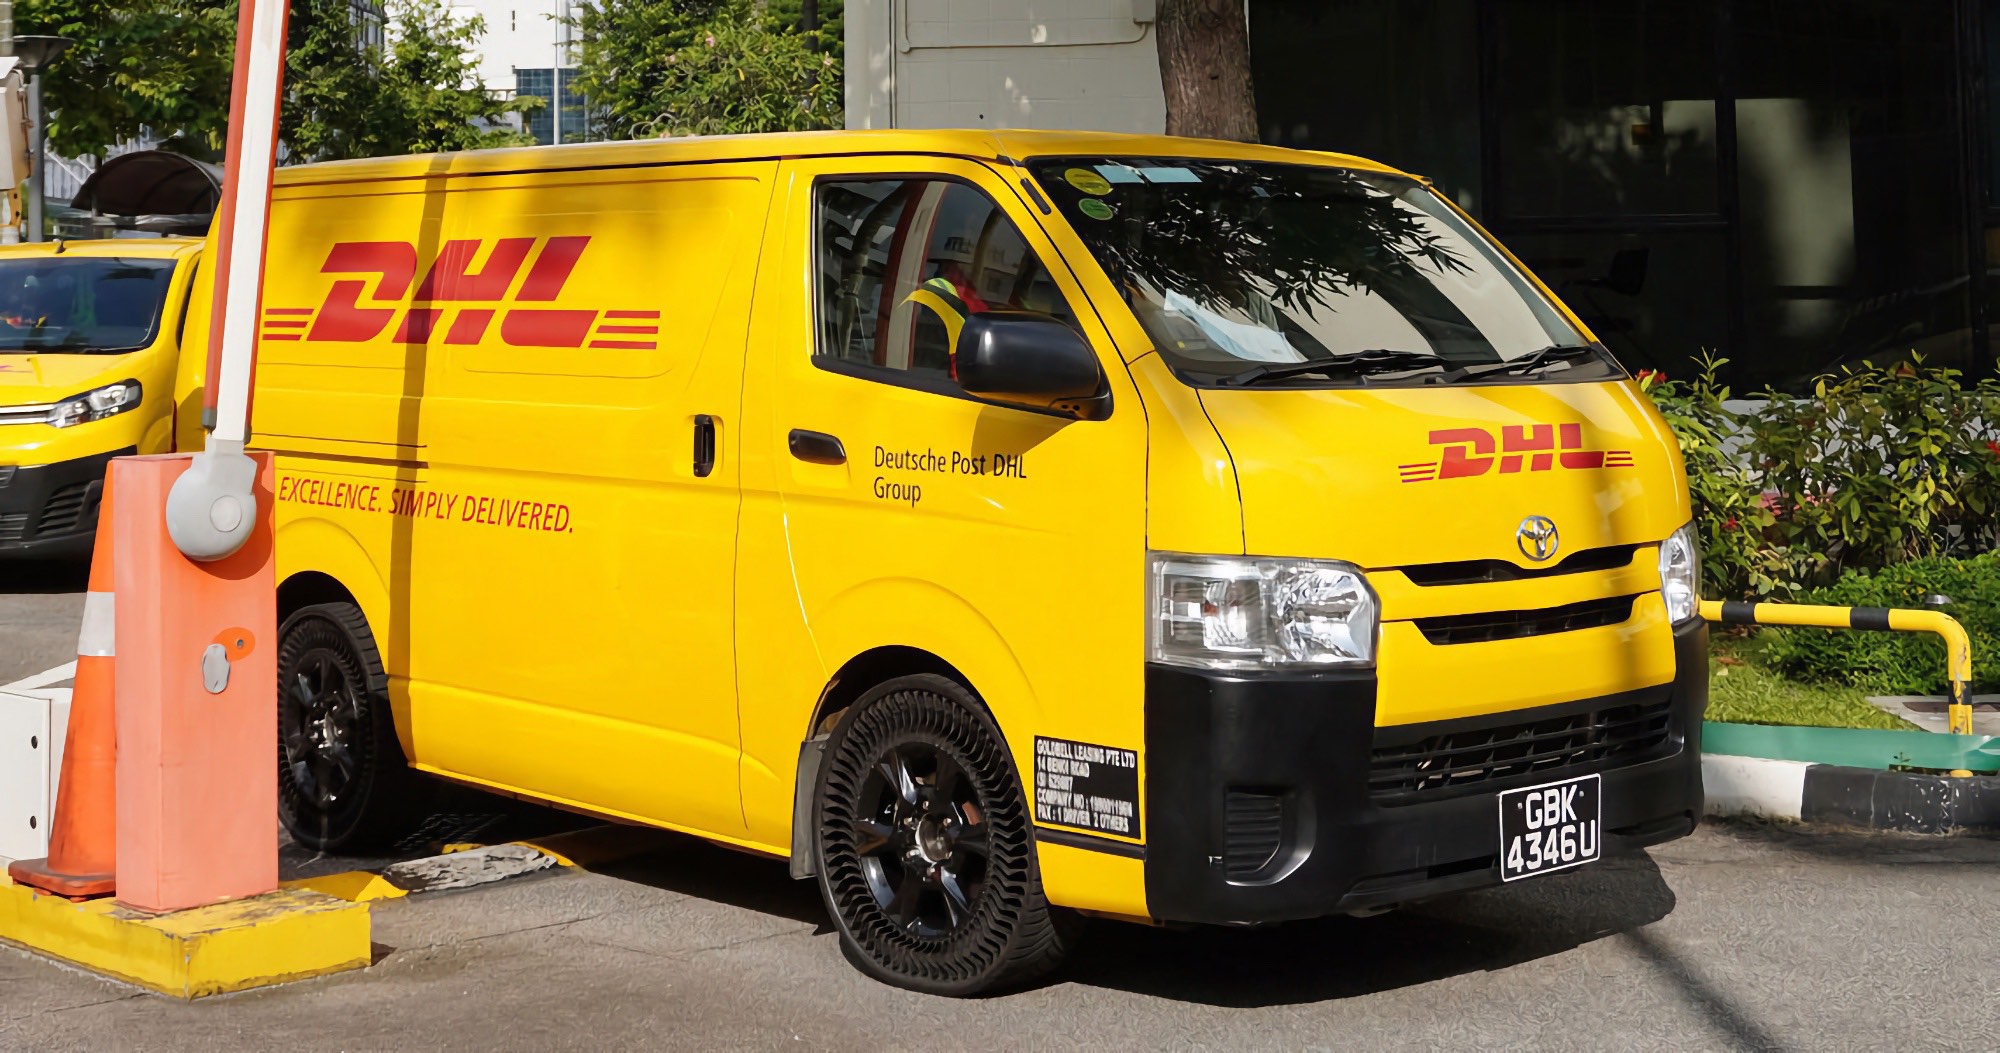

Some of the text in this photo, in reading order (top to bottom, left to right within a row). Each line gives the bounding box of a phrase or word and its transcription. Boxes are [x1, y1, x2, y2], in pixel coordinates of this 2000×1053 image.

[306, 235, 599, 348] DHL
[874, 445, 1027, 479] Deutsche Post DHL
[1428, 422, 1605, 480] DHL
[278, 476, 574, 534] EXCELLENCE. SIMPLY DELIVERED.
[873, 476, 921, 508] Group
[1105, 749, 1120, 767] PTE
[1121, 751, 1136, 768] LTD
[1525, 784, 1578, 830] GBK
[1507, 819, 1596, 873] 4346U
